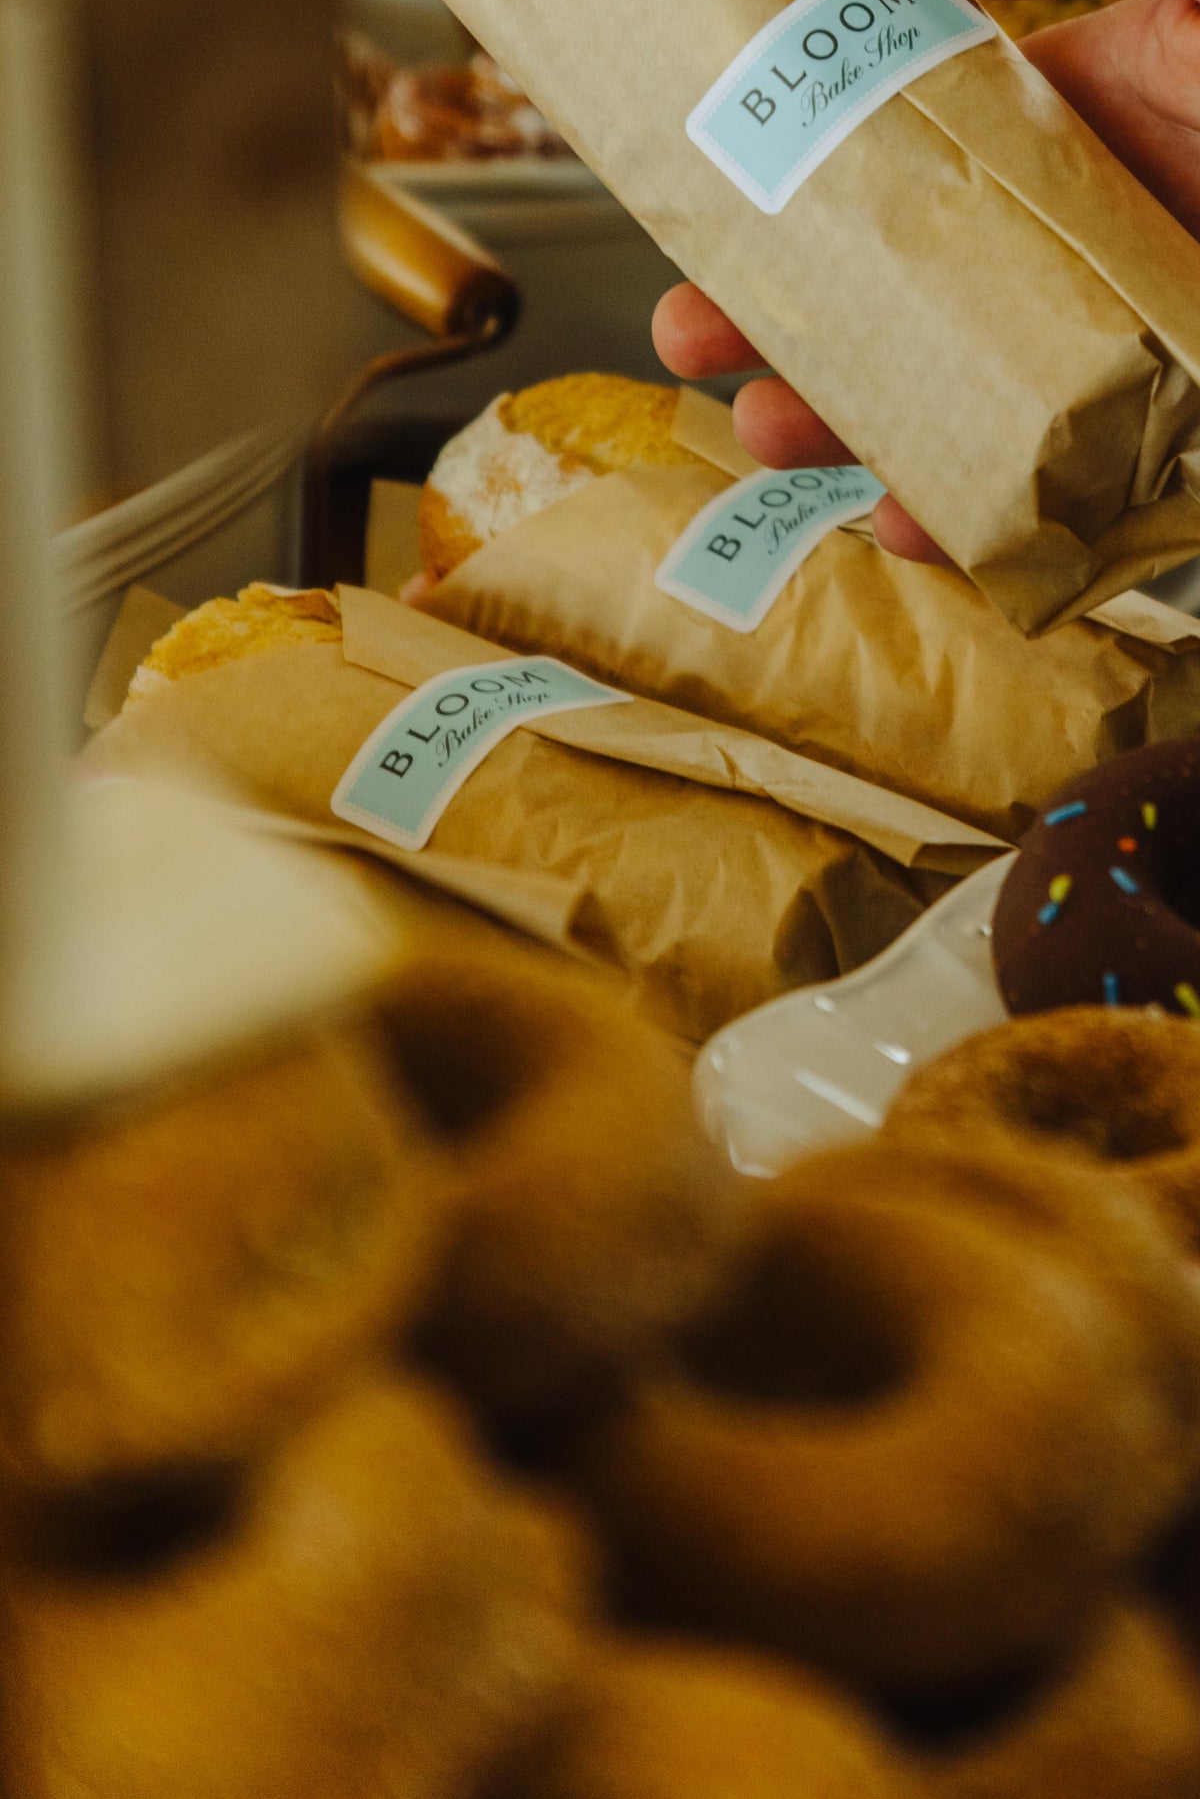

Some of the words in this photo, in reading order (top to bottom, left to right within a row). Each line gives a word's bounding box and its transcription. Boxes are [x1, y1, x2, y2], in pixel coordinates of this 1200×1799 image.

[801, 59, 865, 127] Bake
[863, 24, 921, 68] Shop
[767, 503, 820, 555] Bake
[378, 668, 552, 780] BLOOM
[437, 706, 496, 768] Bake
[498, 691, 551, 713] Shop
